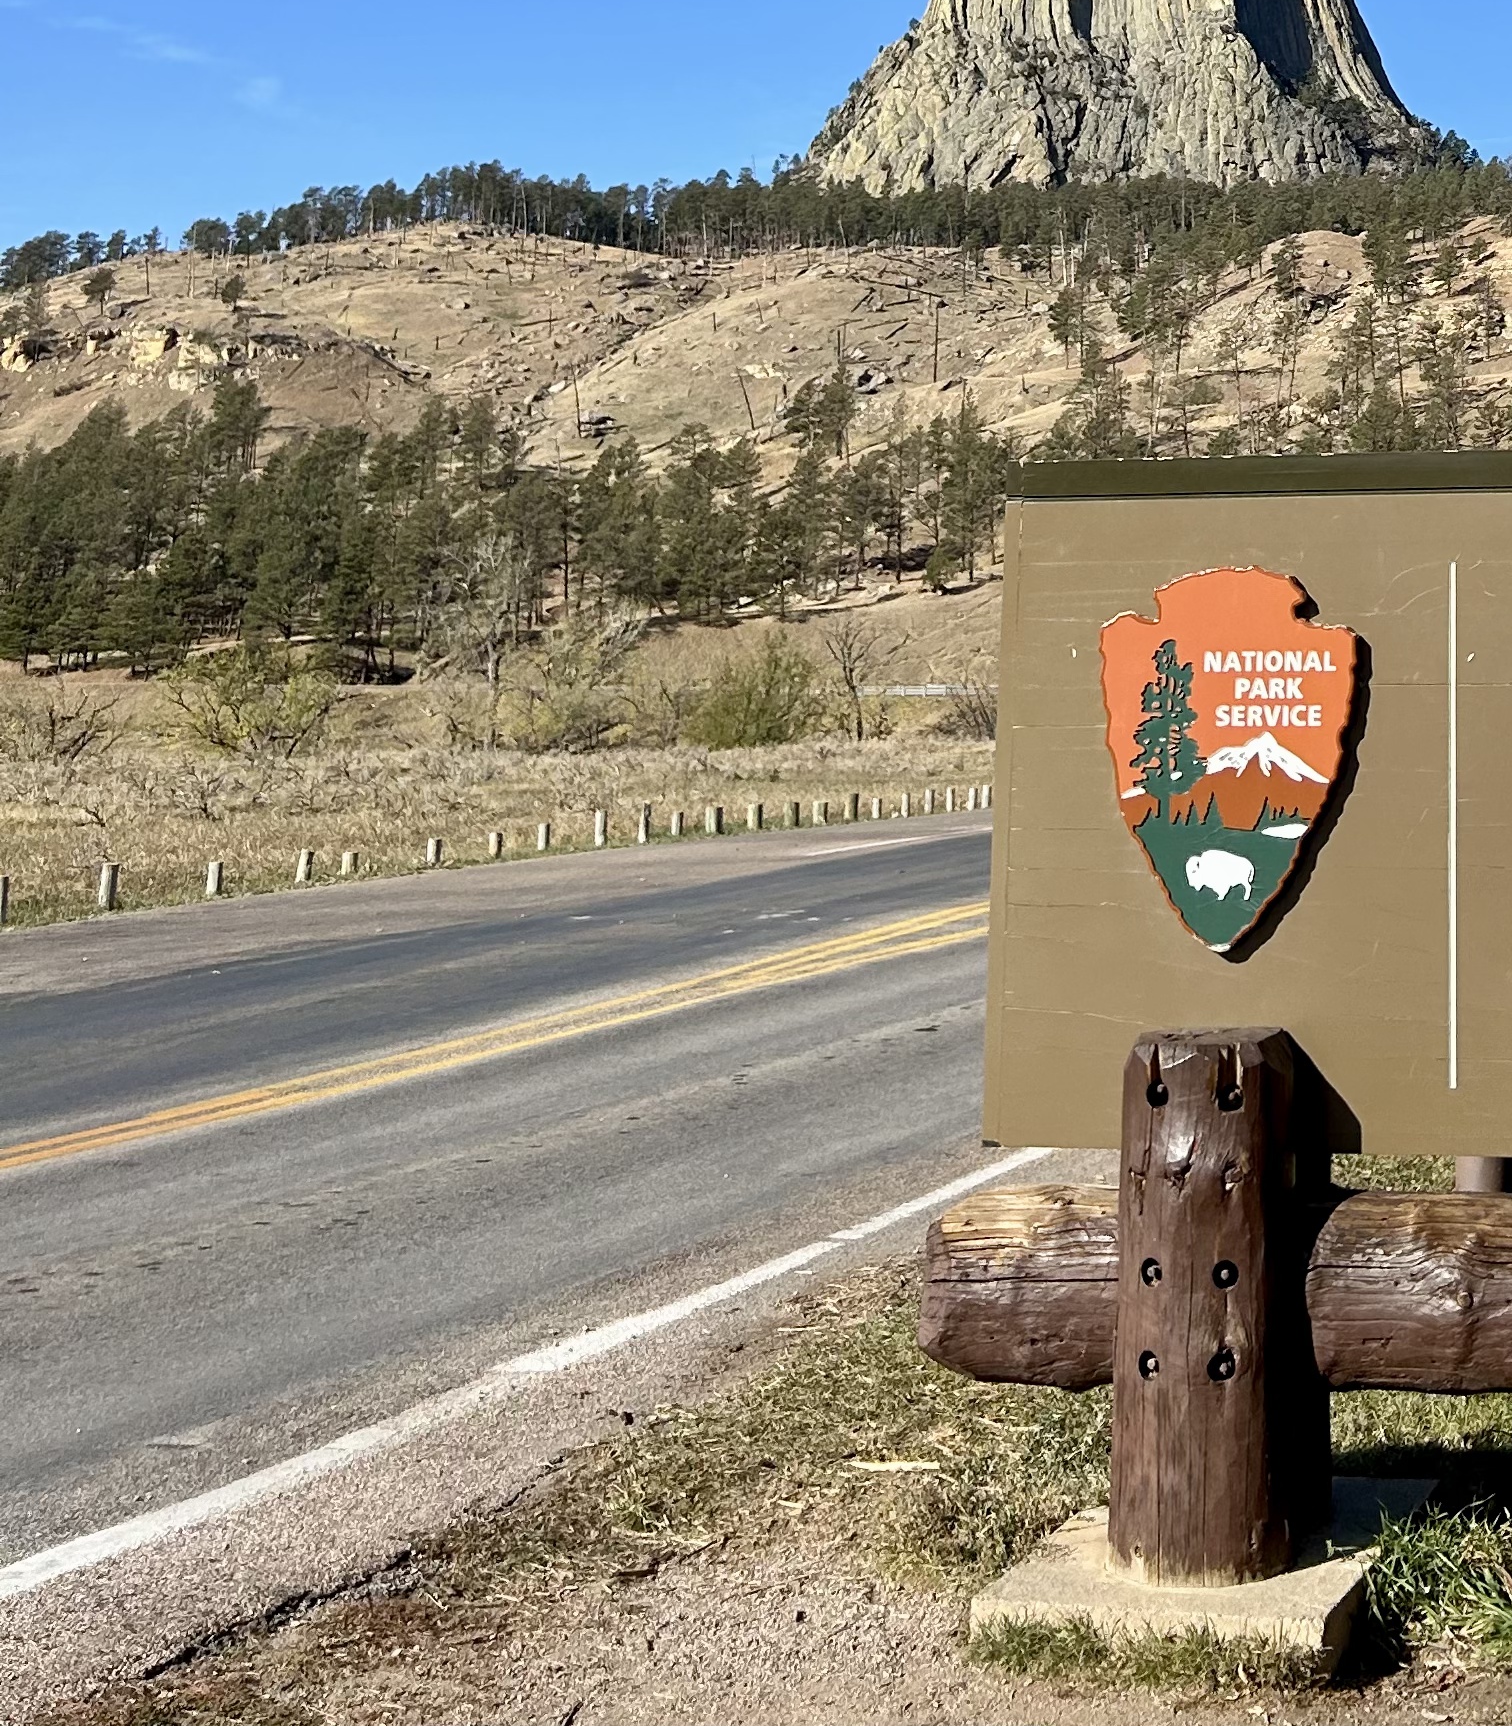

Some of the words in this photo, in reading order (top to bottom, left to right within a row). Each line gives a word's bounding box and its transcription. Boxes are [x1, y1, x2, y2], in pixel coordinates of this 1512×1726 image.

[1203, 650, 1337, 673] NATIONAL
[1234, 677, 1304, 700] PARK
[1215, 704, 1322, 727] SERVICE
